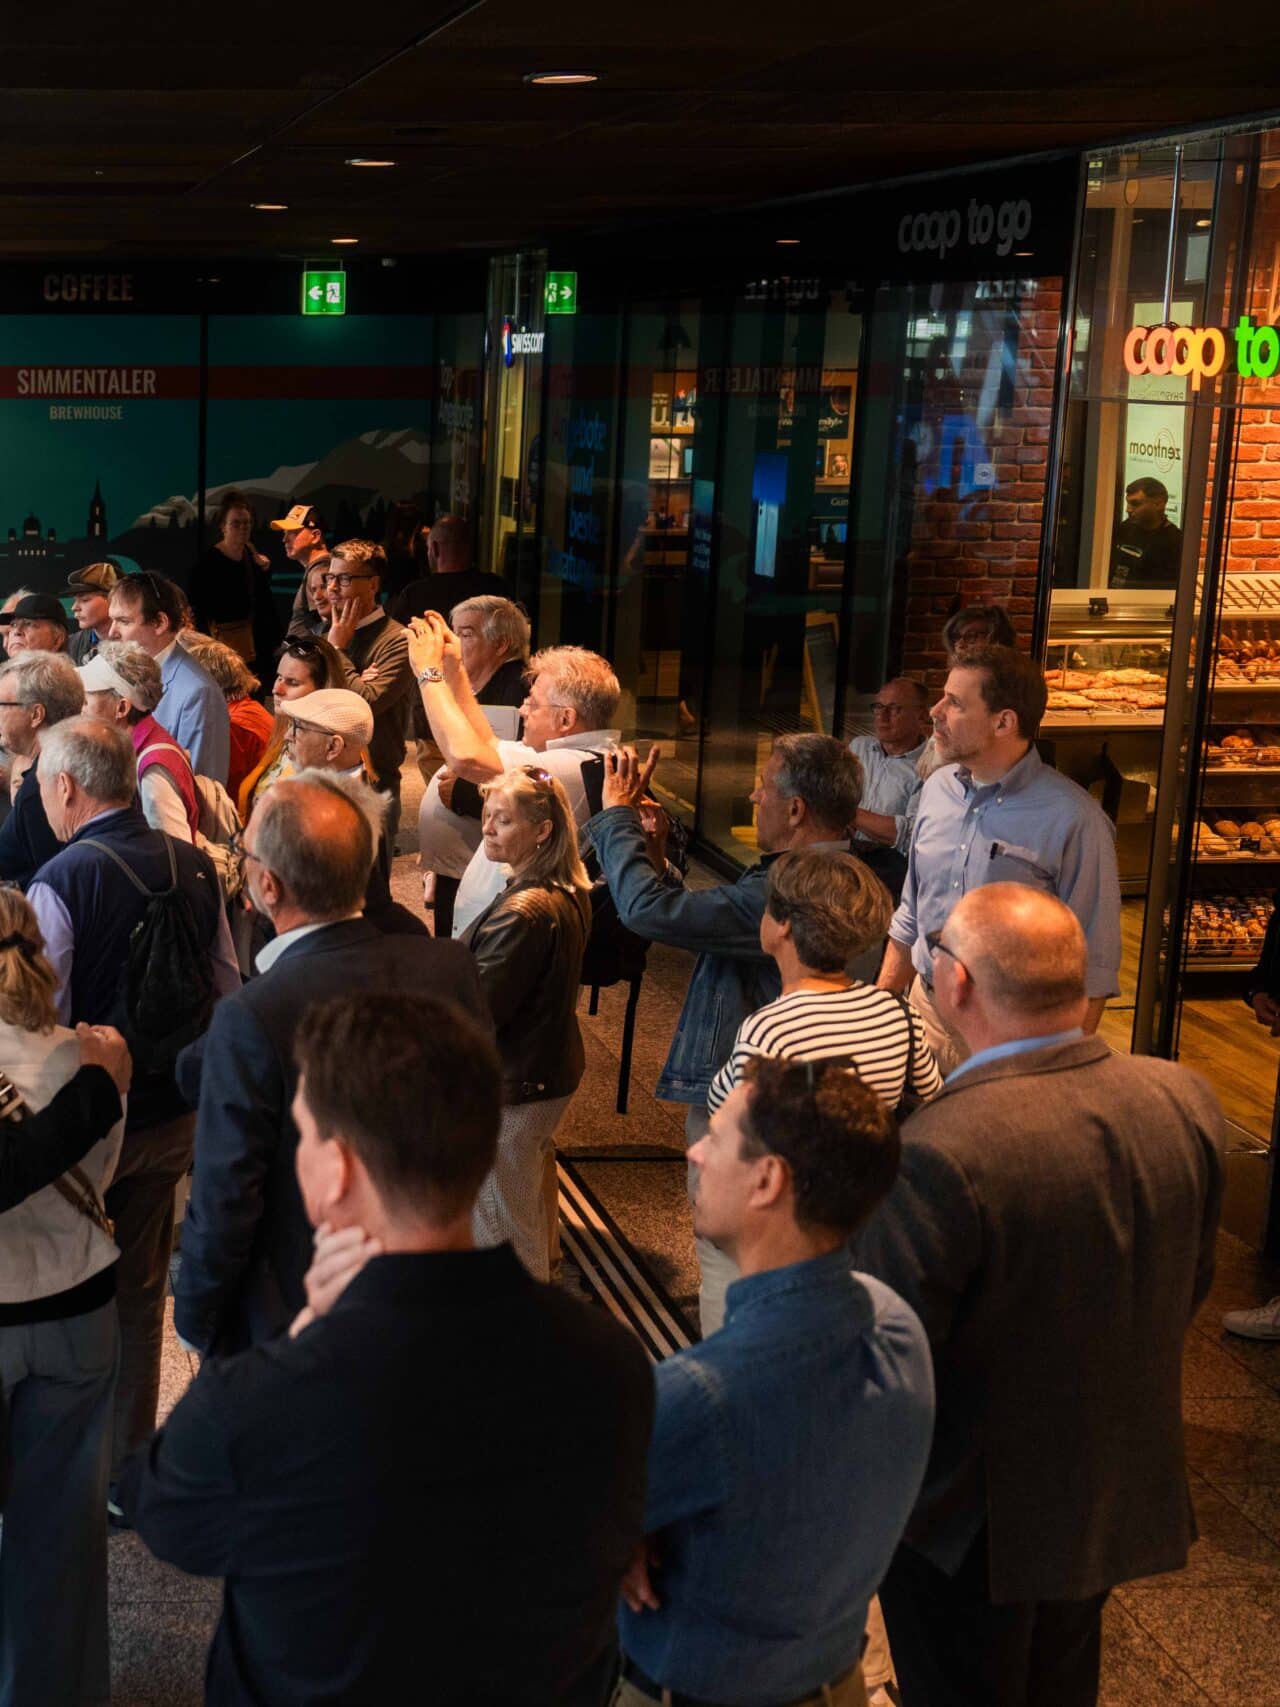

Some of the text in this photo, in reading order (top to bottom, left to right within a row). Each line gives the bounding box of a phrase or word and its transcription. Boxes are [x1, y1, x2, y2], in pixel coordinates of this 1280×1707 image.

[897, 198, 1032, 260] coop to go
[43, 274, 134, 301] COFFEE
[1124, 316, 1280, 391] coop to
[17, 369, 157, 395] SIMMENTALER
[49, 405, 124, 420] BREWHOUSE
